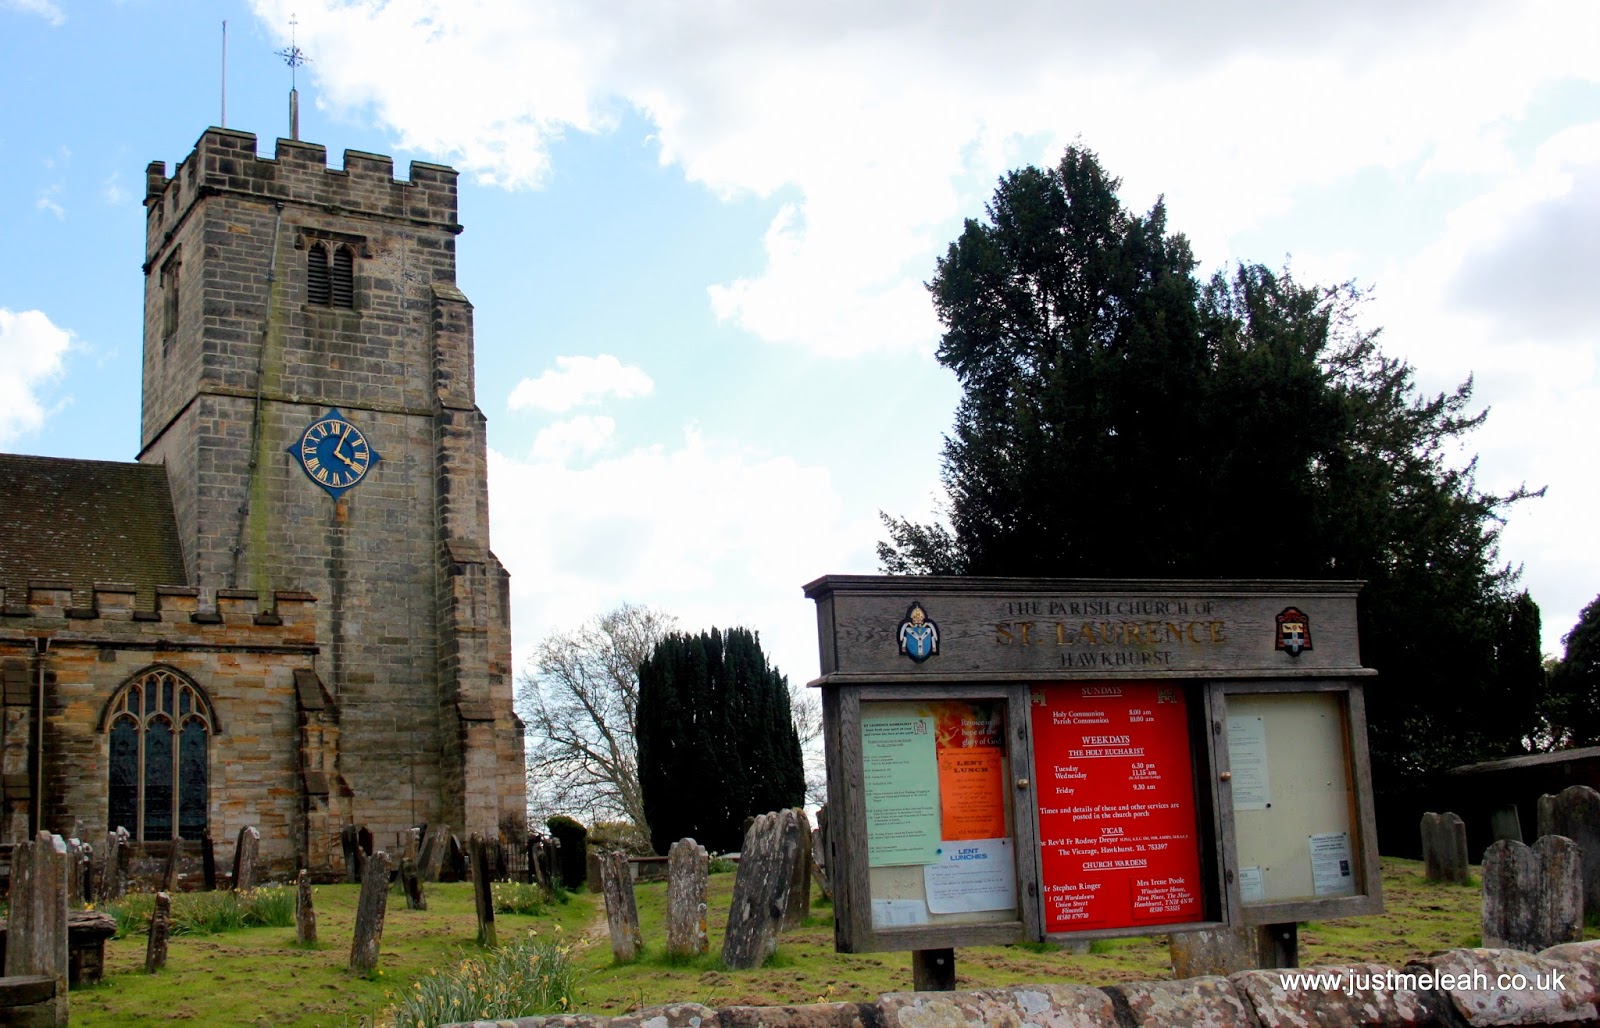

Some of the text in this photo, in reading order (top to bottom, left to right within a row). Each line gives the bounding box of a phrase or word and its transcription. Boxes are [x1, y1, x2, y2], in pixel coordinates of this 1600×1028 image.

[1008, 601, 1216, 615] THE PARISH CHURCH OF
[996, 620, 1227, 645] ST. LAURENCE
[1060, 652, 1172, 666] HAWKHURST
[1082, 686, 1122, 694] SUNDAYS
[1053, 711, 1066, 720] Holy
[961, 719, 984, 728] Rejoice
[961, 728, 977, 737] hope
[962, 738, 978, 747] glory
[1082, 735, 1130, 744] WEEKDAYS
[1073, 813, 1092, 822] posted
[1134, 811, 1150, 819] porch
[1075, 838, 1097, 846] Rodney
[1053, 884, 1077, 892] Stephen
[1079, 883, 1101, 891] Ringer
